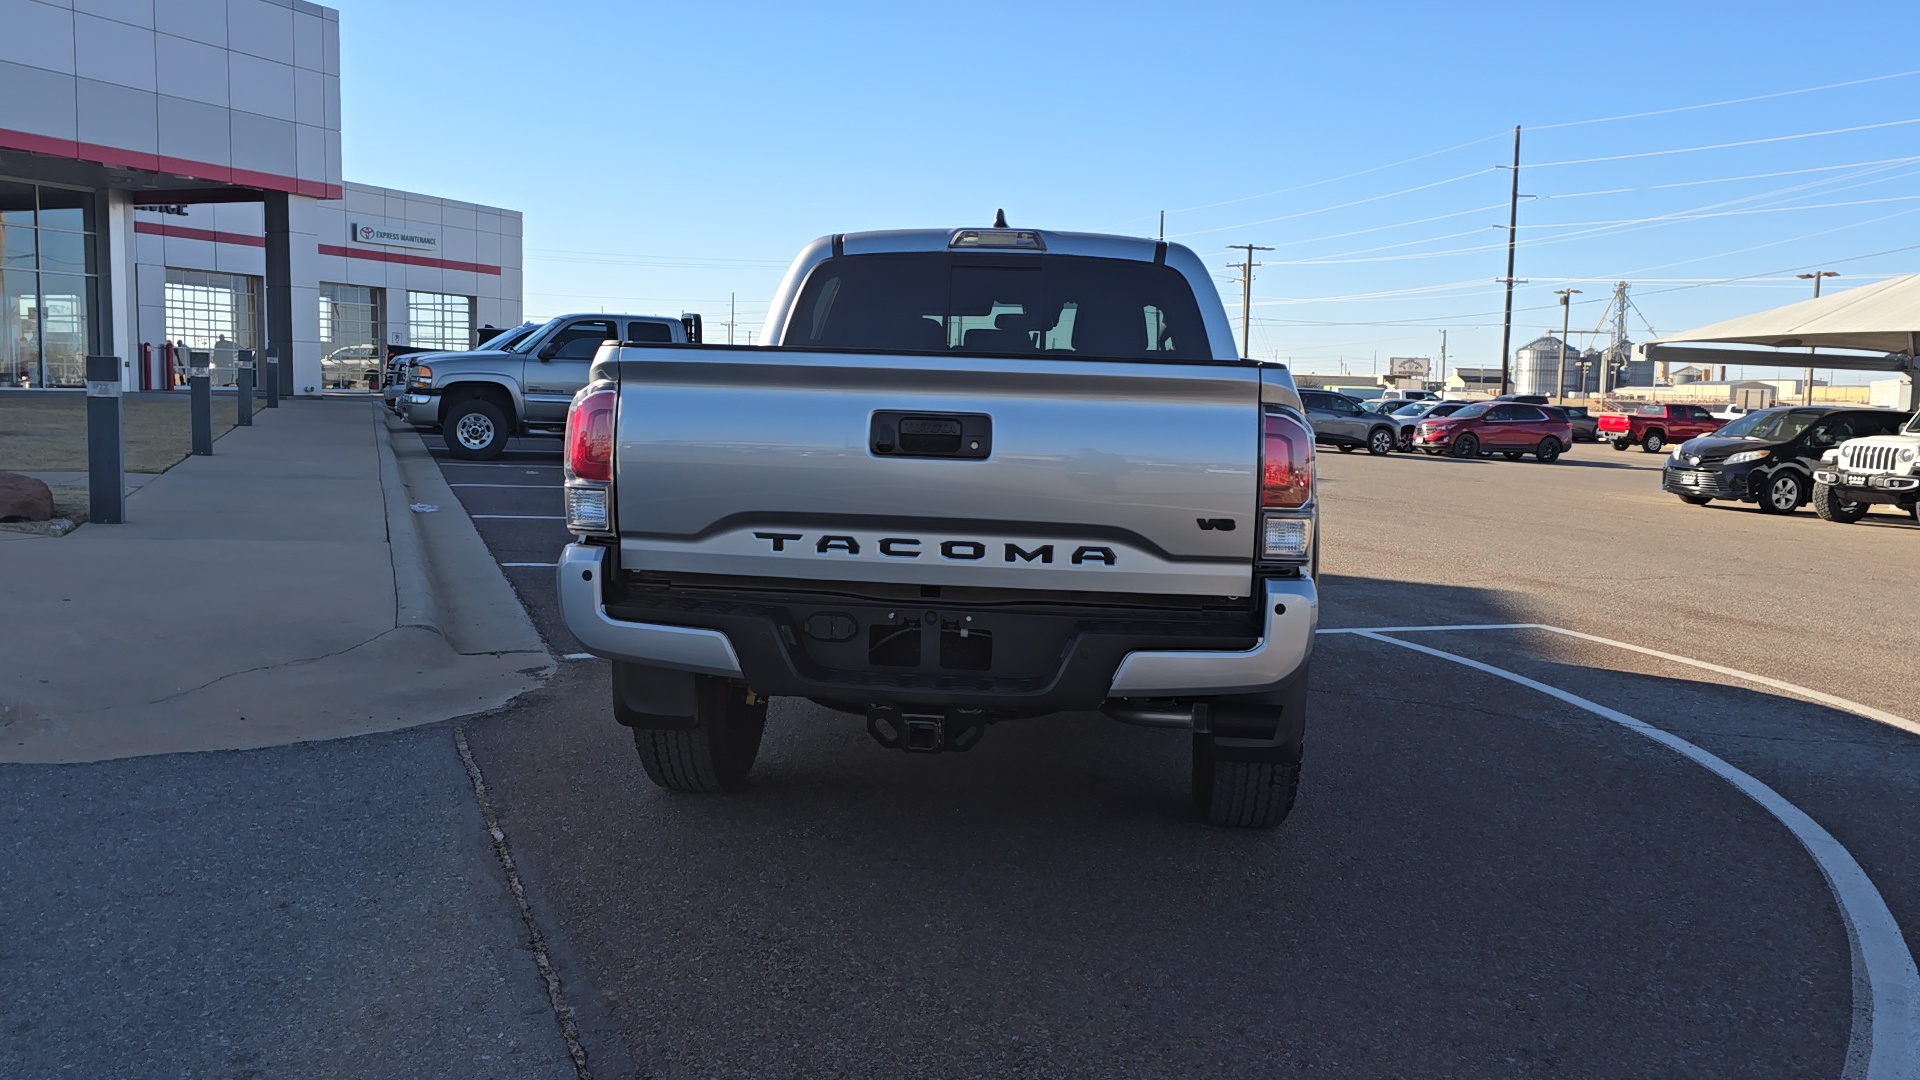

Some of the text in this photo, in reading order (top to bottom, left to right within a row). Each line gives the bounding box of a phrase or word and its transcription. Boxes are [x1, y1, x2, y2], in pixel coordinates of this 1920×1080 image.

[376, 230, 436, 246] EXPRESS MAINTENANCE
[904, 422, 957, 434] TOYOTA
[752, 532, 1118, 566] TACOMA
